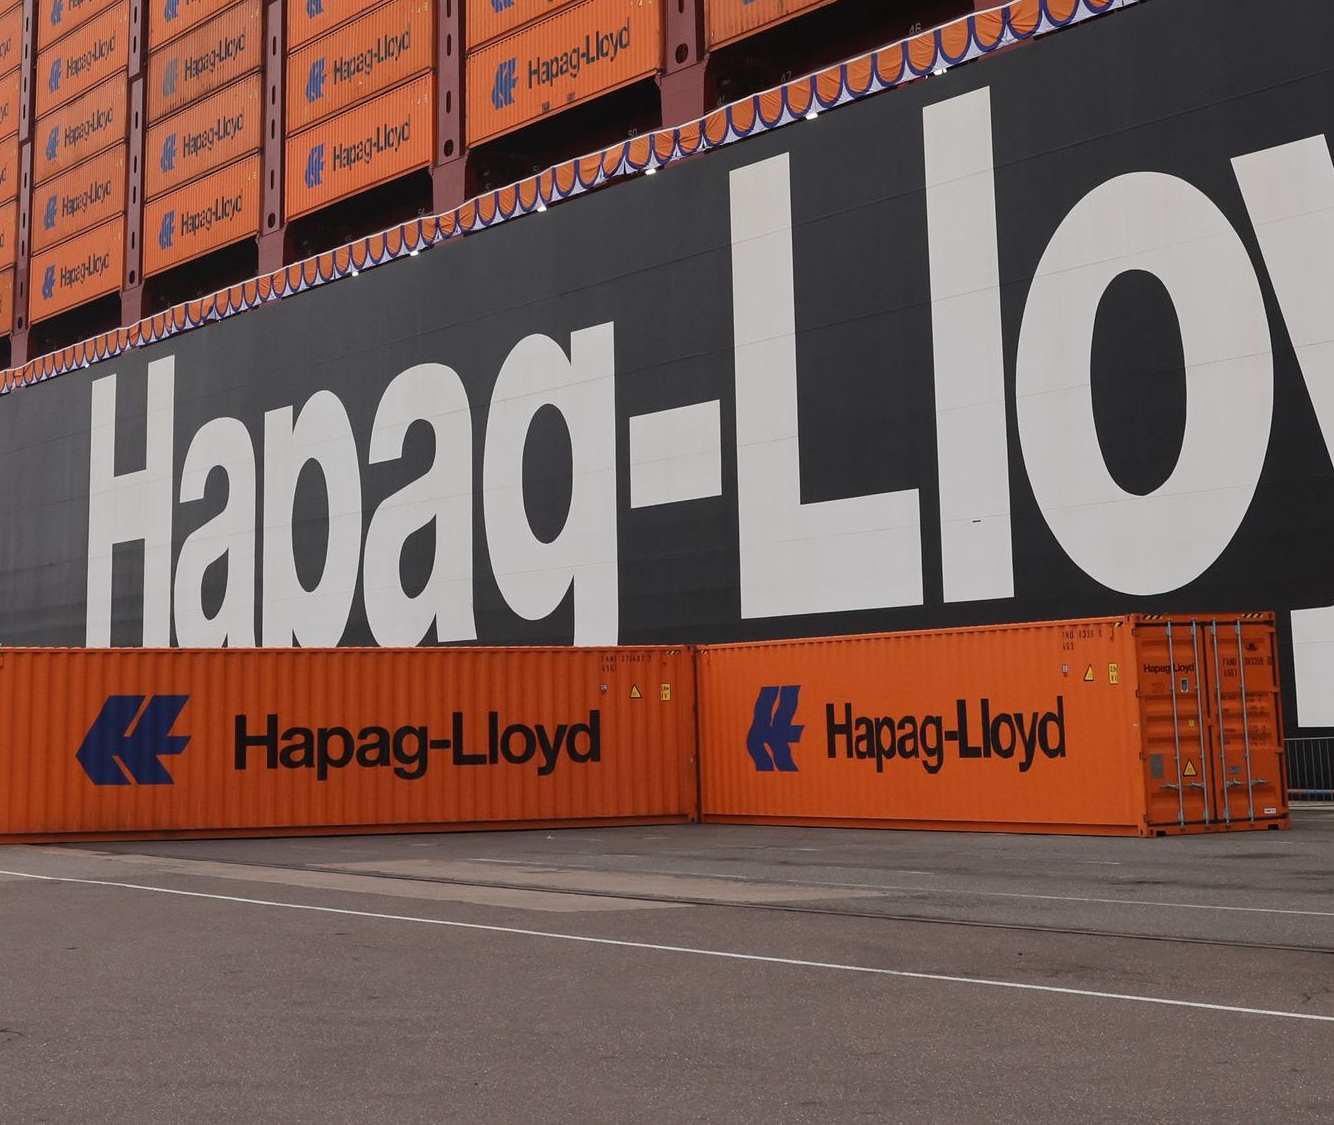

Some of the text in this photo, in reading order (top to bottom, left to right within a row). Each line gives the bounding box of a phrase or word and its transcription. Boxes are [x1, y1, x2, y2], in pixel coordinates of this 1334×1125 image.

[528, 18, 630, 88] Hapag-Lloyd
[234, 709, 602, 781] Hapag-Lloyd
[826, 695, 1066, 774] Hapag-Lloyd
